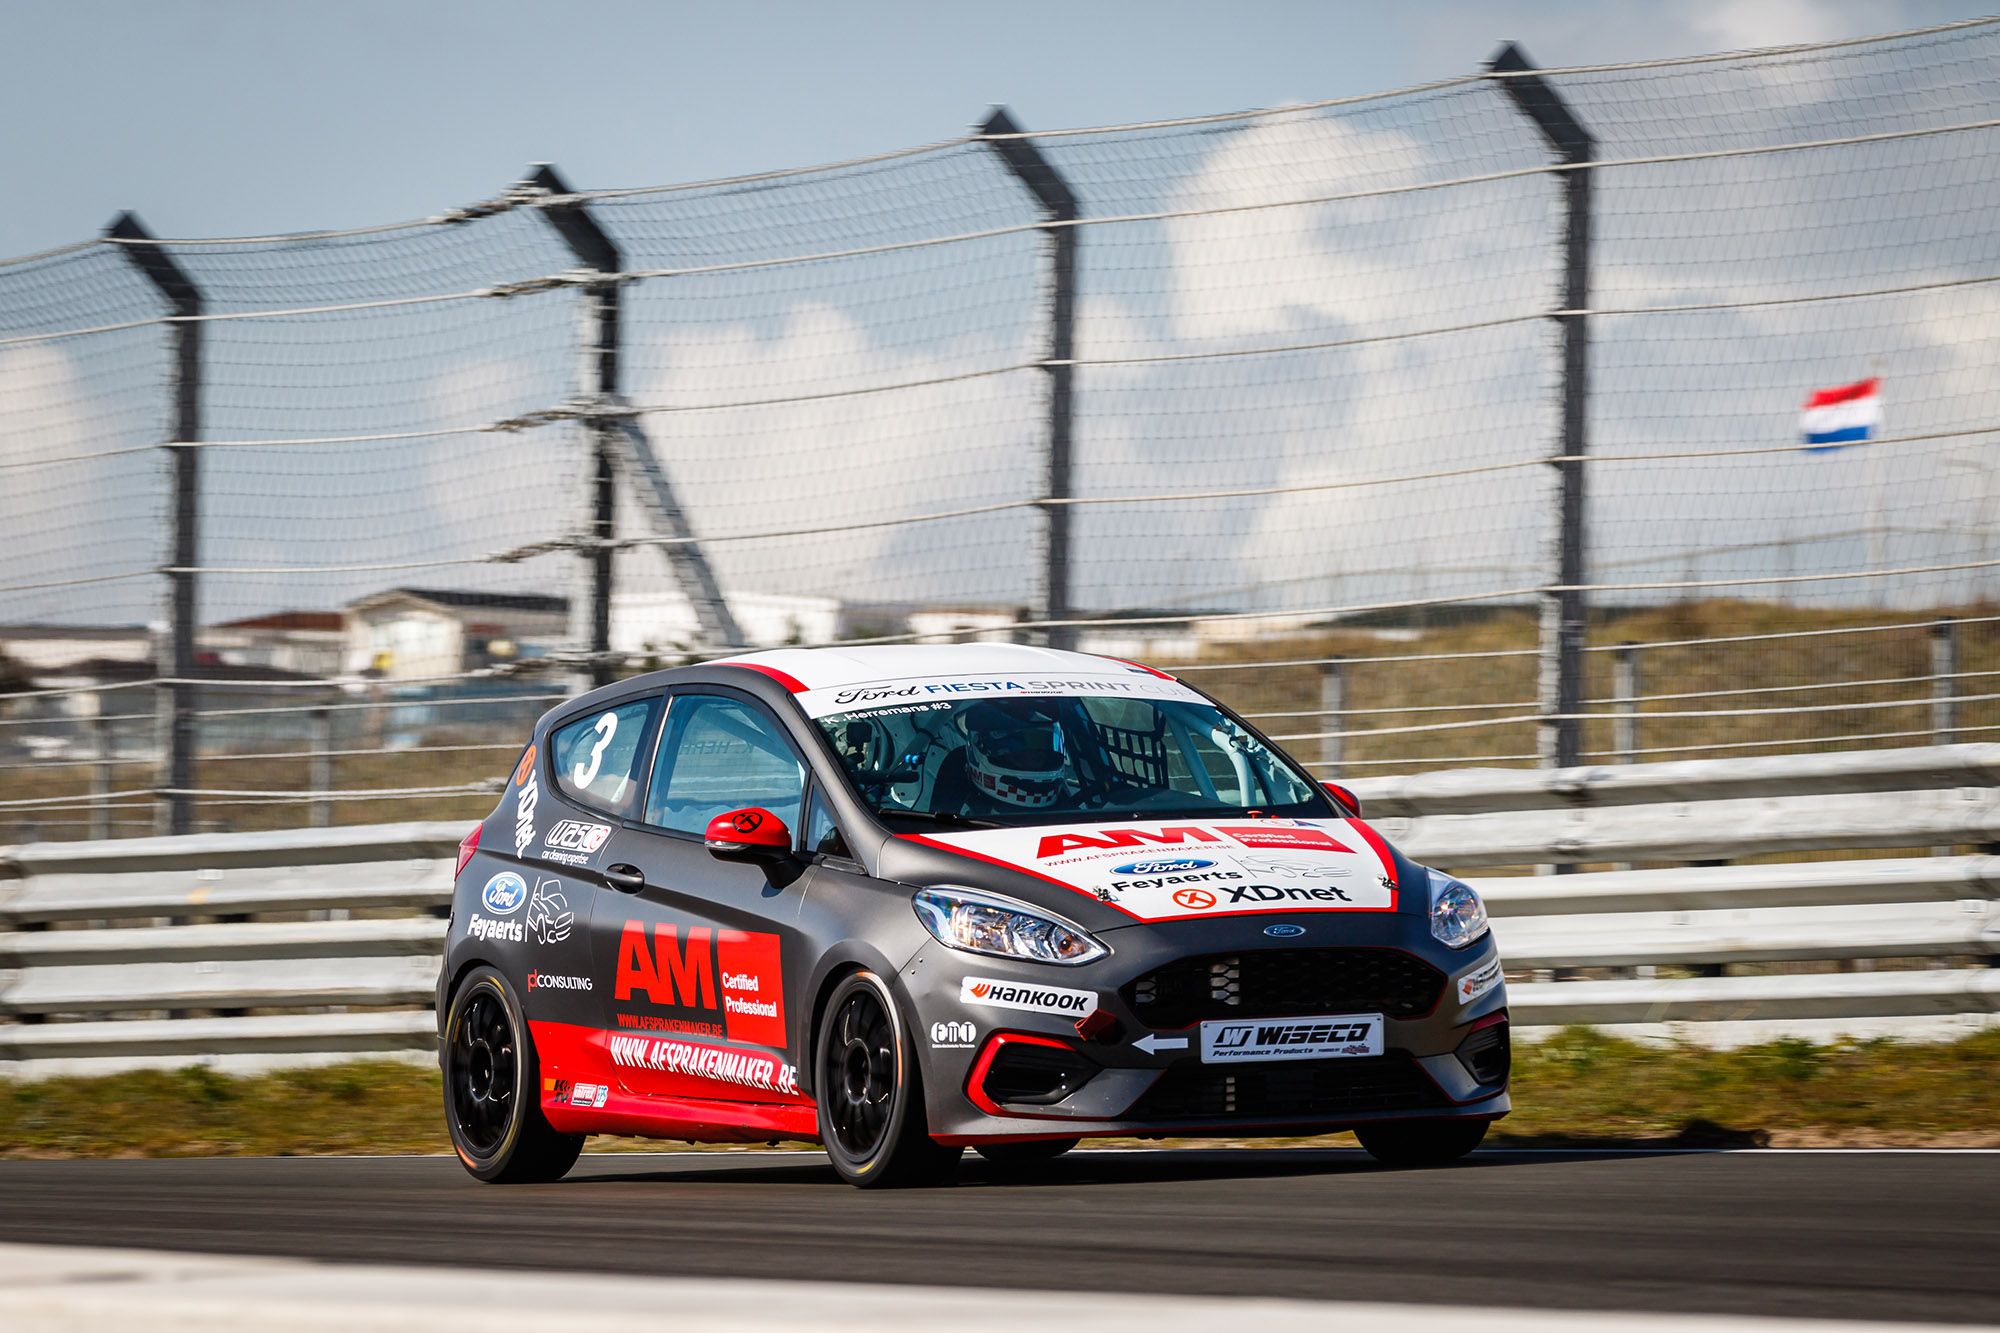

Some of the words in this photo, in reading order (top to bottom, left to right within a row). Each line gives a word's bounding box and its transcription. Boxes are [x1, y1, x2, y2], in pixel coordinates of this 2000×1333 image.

[835, 685, 921, 704] Ford
[924, 681, 1025, 694] FIESTA
[1027, 681, 1130, 692] SPRINT
[574, 711, 618, 790] 3
[1036, 827, 1222, 859] AM
[1132, 860, 1198, 873] Ford
[488, 878, 519, 907] Ford
[1111, 870, 1243, 892] Feyaerts
[1218, 884, 1353, 904] XDnet
[467, 913, 523, 942] Feyaerts
[614, 919, 718, 1010] AM
[722, 971, 759, 992] Certified
[725, 996, 777, 1018] Professional
[617, 1013, 724, 1039] WWW.AFSPRAKENMAKER.BE
[1213, 1049, 1271, 1057] Performance
[1272, 1047, 1314, 1055] Products
